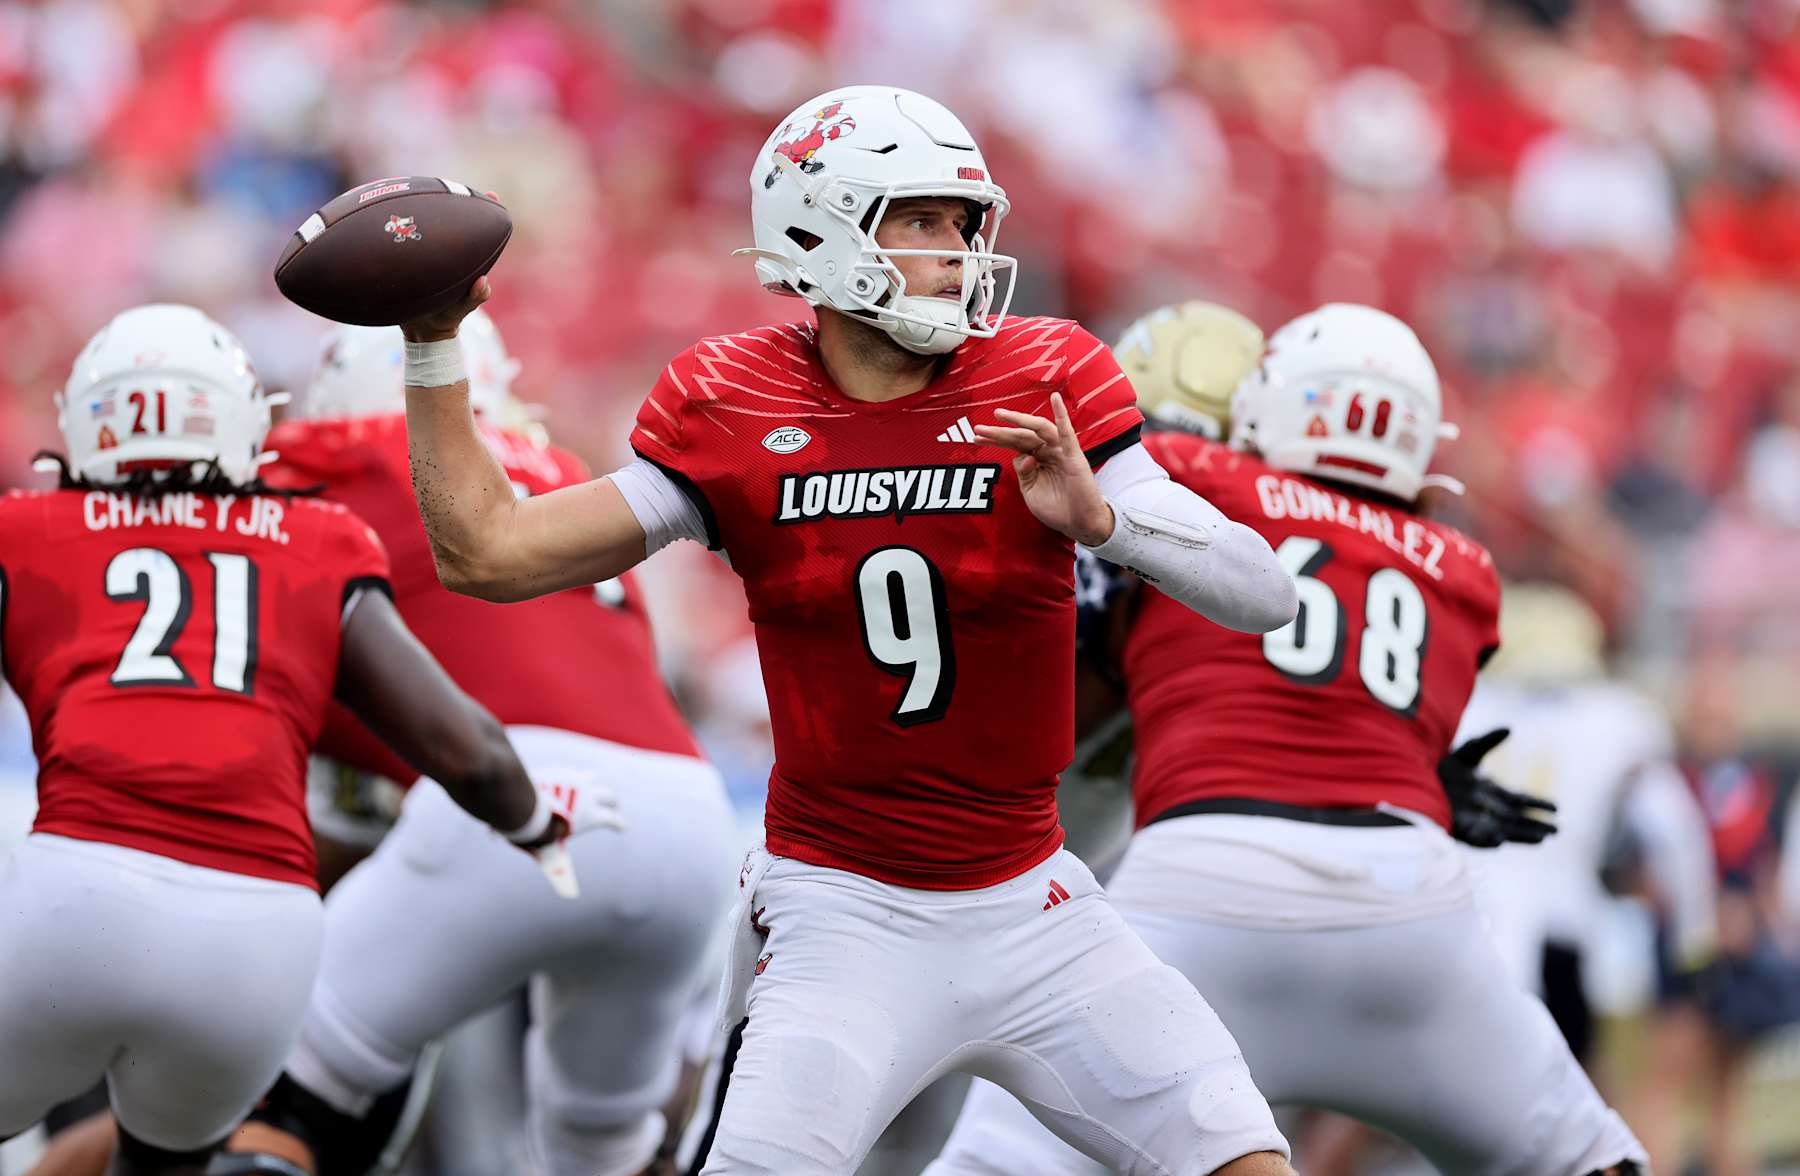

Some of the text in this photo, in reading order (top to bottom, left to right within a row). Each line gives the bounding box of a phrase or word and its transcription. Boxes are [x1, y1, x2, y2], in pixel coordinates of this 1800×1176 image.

[129, 390, 166, 434] 21
[770, 432, 802, 445] ACC
[1346, 392, 1391, 438] 68
[83, 490, 290, 545] CHANEY JR.
[778, 467, 997, 521] LOUISVILLE
[105, 547, 256, 694] 21
[856, 546, 951, 722] 9
[1262, 536, 1428, 717] 68
